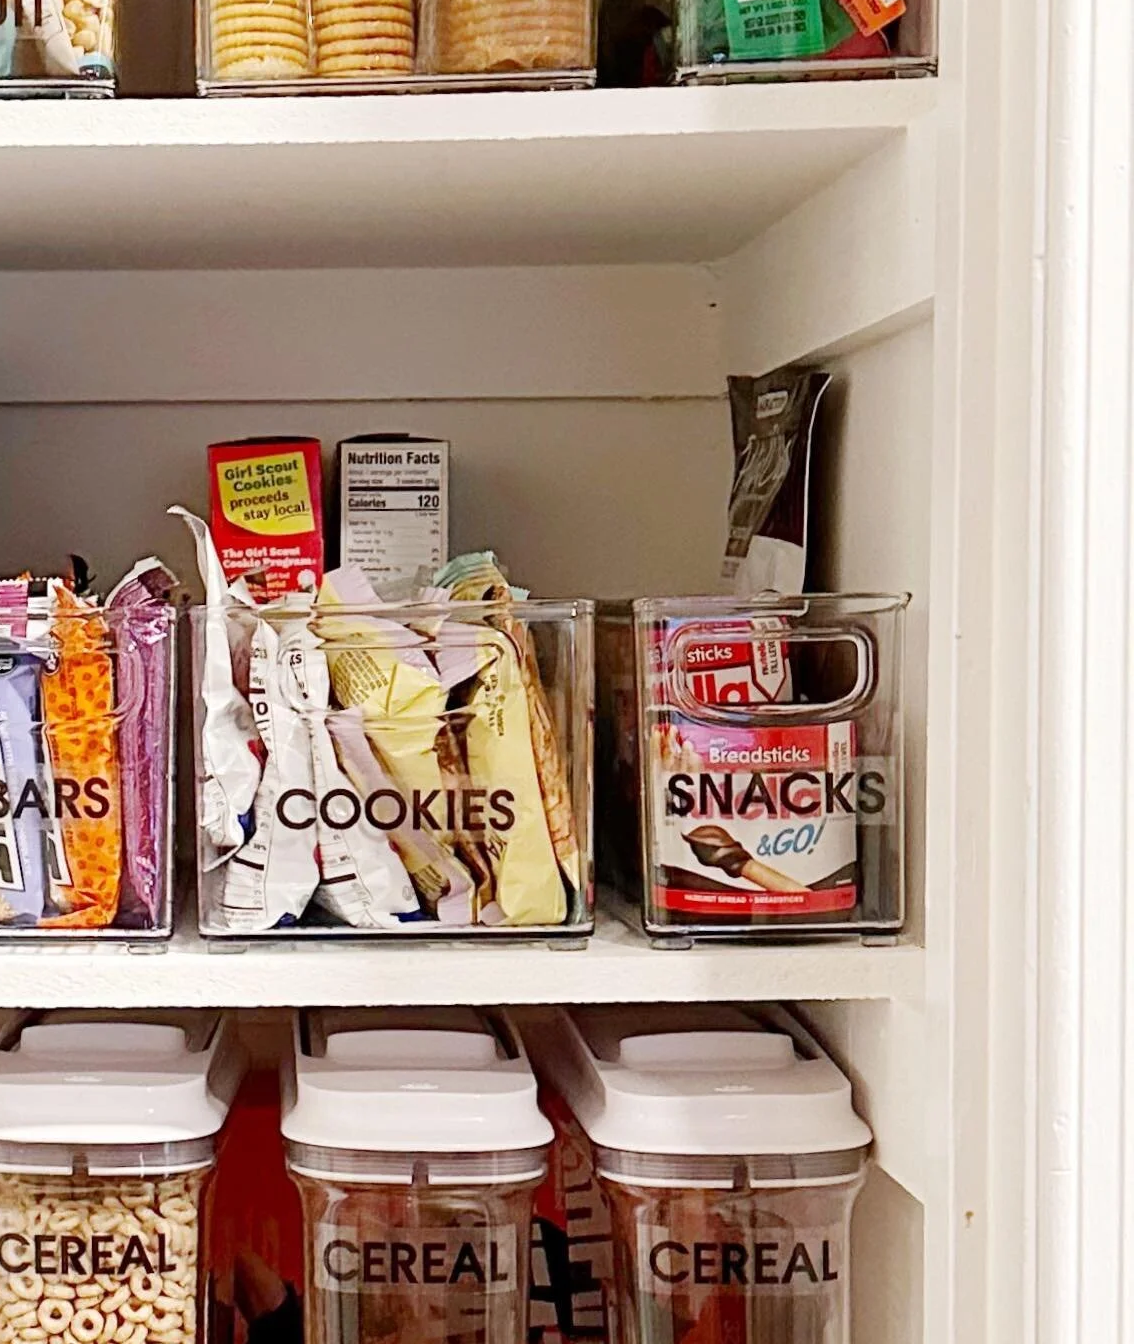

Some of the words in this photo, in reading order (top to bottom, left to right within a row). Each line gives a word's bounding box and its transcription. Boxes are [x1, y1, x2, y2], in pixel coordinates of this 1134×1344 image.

[348, 452, 402, 465] Nutrition
[406, 452, 441, 465] Facts
[224, 465, 253, 481] Girl
[255, 459, 298, 476] Scout
[229, 490, 289, 511] proceeds
[347, 497, 387, 508] Calories
[417, 494, 440, 508] 120
[243, 507, 271, 521] stay
[222, 547, 244, 559] The
[708, 746, 811, 765] Breadsticks
[667, 770, 887, 817] SNACKS
[276, 788, 517, 832] COOKIES
[323, 1237, 509, 1286] CEREAL
[649, 1237, 839, 1286] CEREAL
